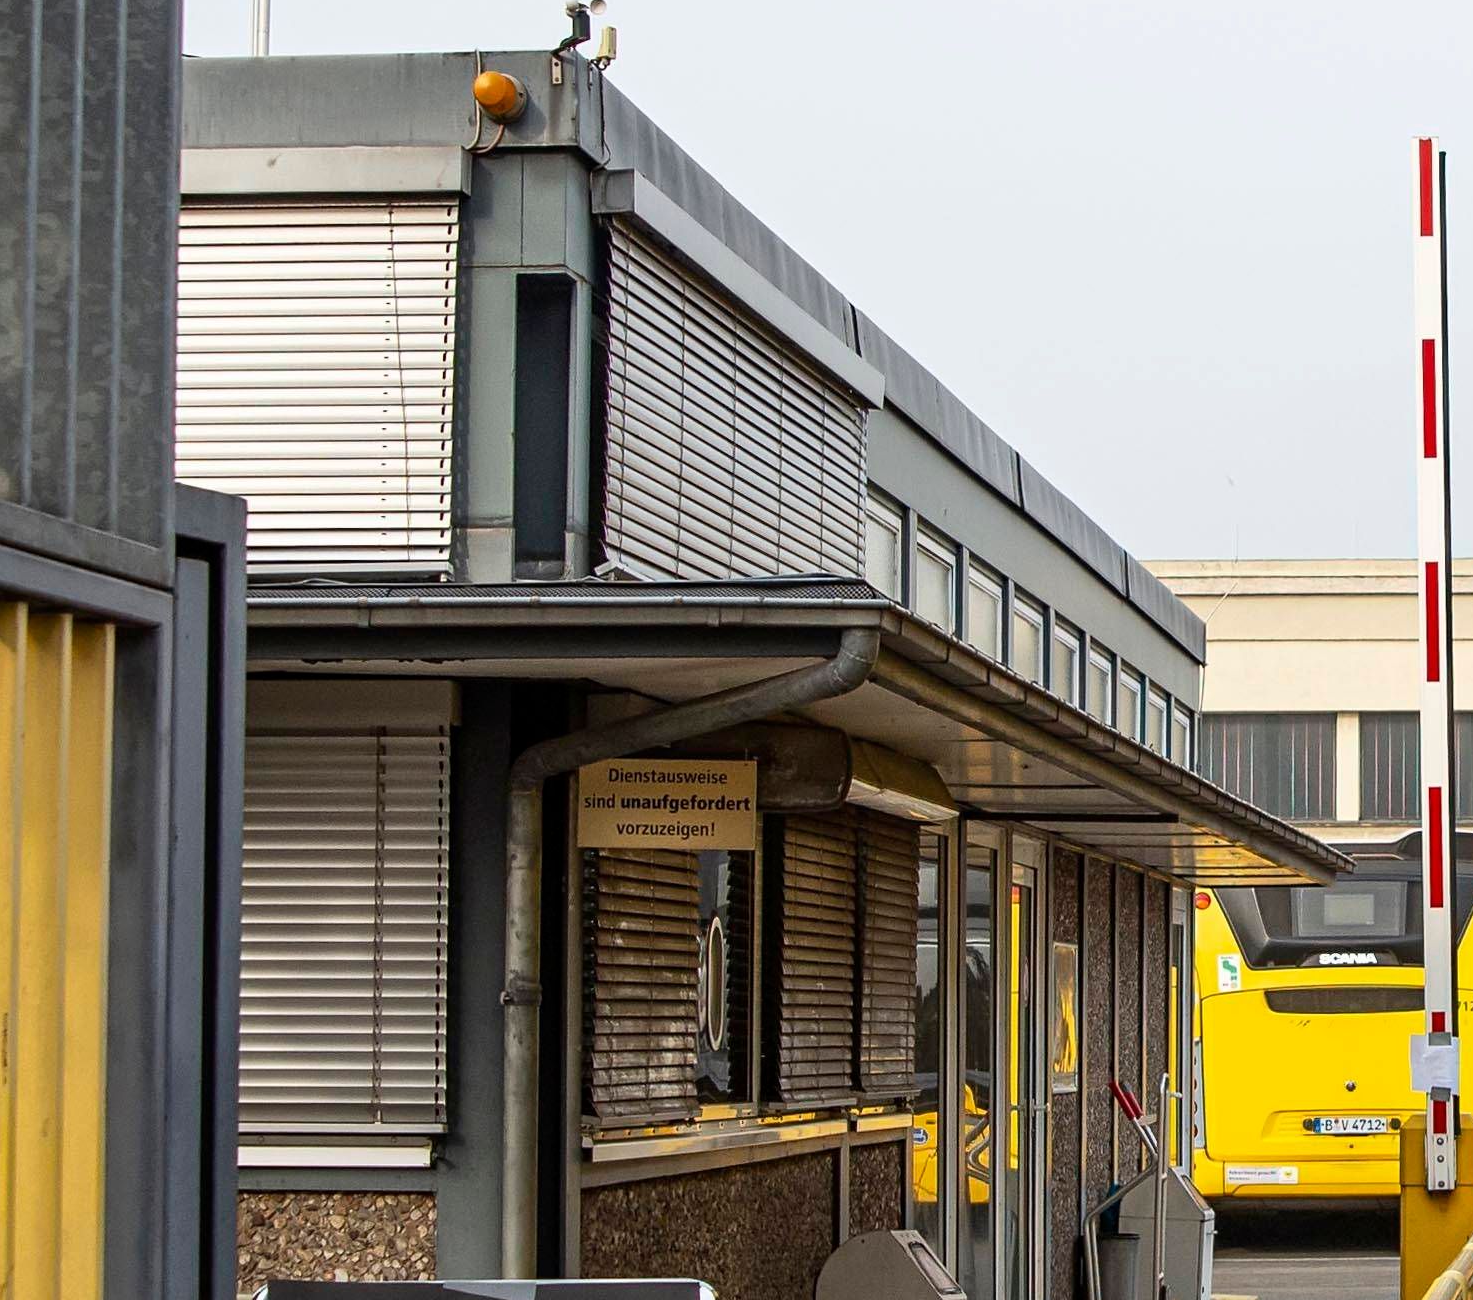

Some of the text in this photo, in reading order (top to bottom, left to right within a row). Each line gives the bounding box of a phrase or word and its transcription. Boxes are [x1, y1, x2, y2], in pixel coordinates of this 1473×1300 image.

[608, 768, 728, 785] Dienstausweise
[584, 793, 750, 814] sind unaufgefordert
[616, 821, 715, 841] vorzuzeigen!
[1318, 952, 1378, 965] SCANIA
[1352, 1119, 1381, 1131] 4712
